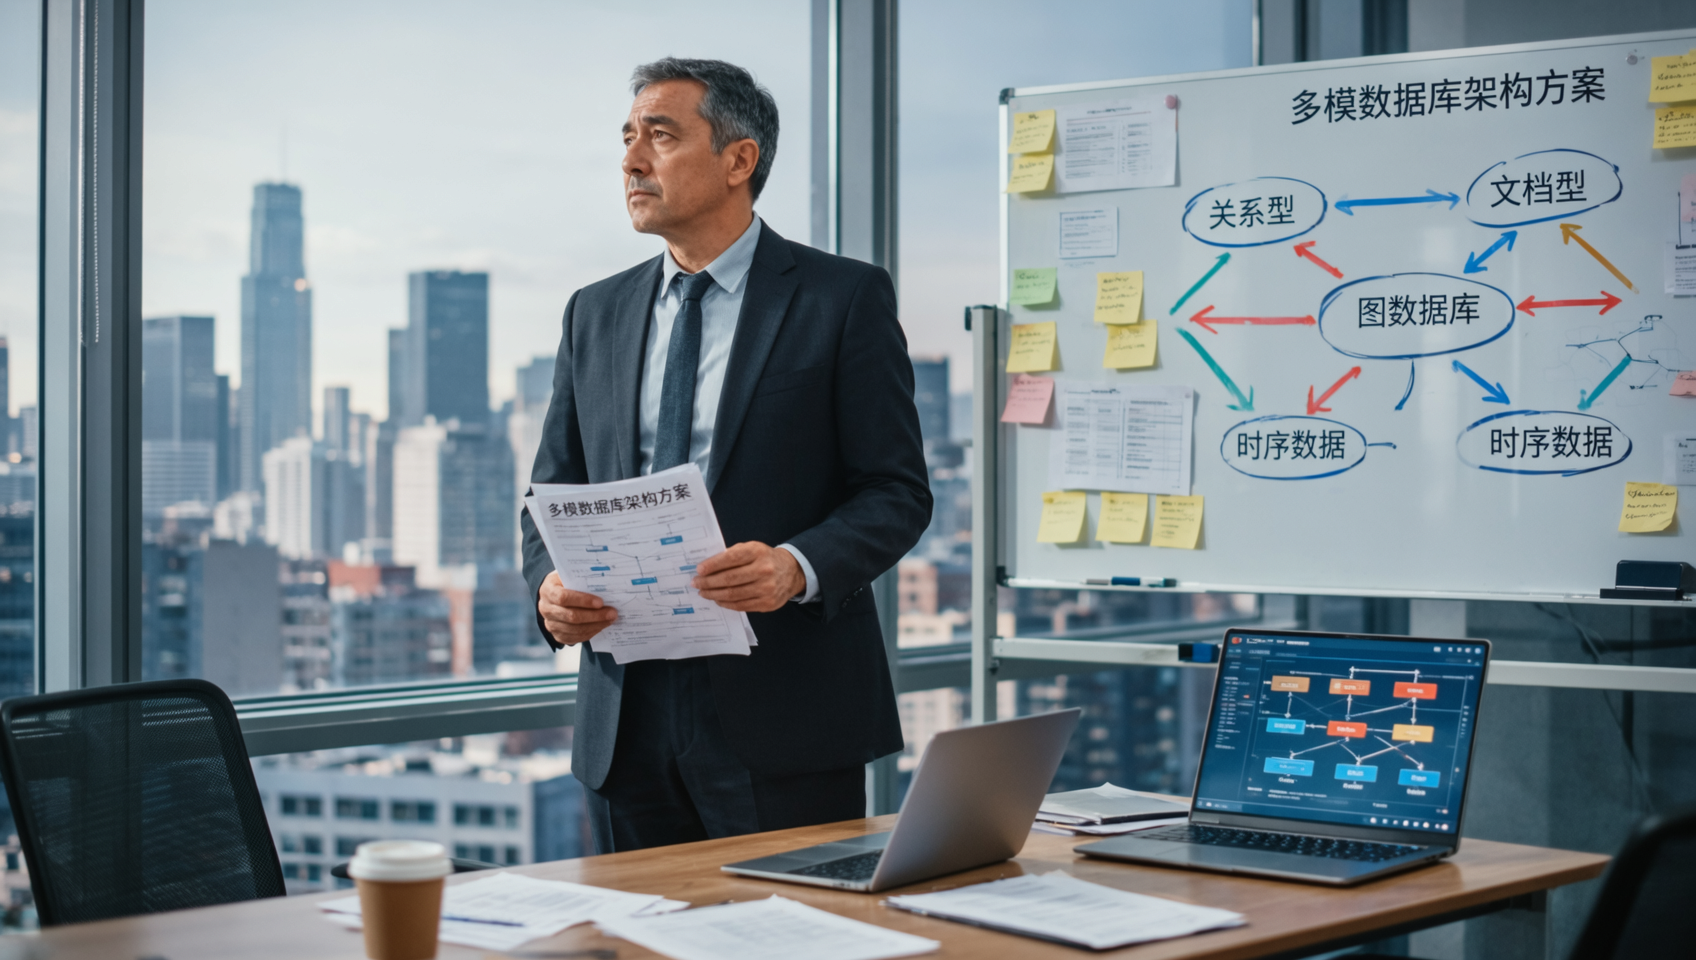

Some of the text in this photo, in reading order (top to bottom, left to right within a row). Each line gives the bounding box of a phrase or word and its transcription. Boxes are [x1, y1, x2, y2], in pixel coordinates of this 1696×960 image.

[1291, 66, 1606, 125] 多模数据库架构方案
[1489, 169, 1588, 208] 文档型
[1209, 194, 1295, 230] 关系型
[1358, 292, 1480, 328] 图数据库
[1236, 430, 1346, 460] 时序数据
[1489, 425, 1614, 460] 时序数据
[548, 484, 691, 517] 多模数据库架构方案
